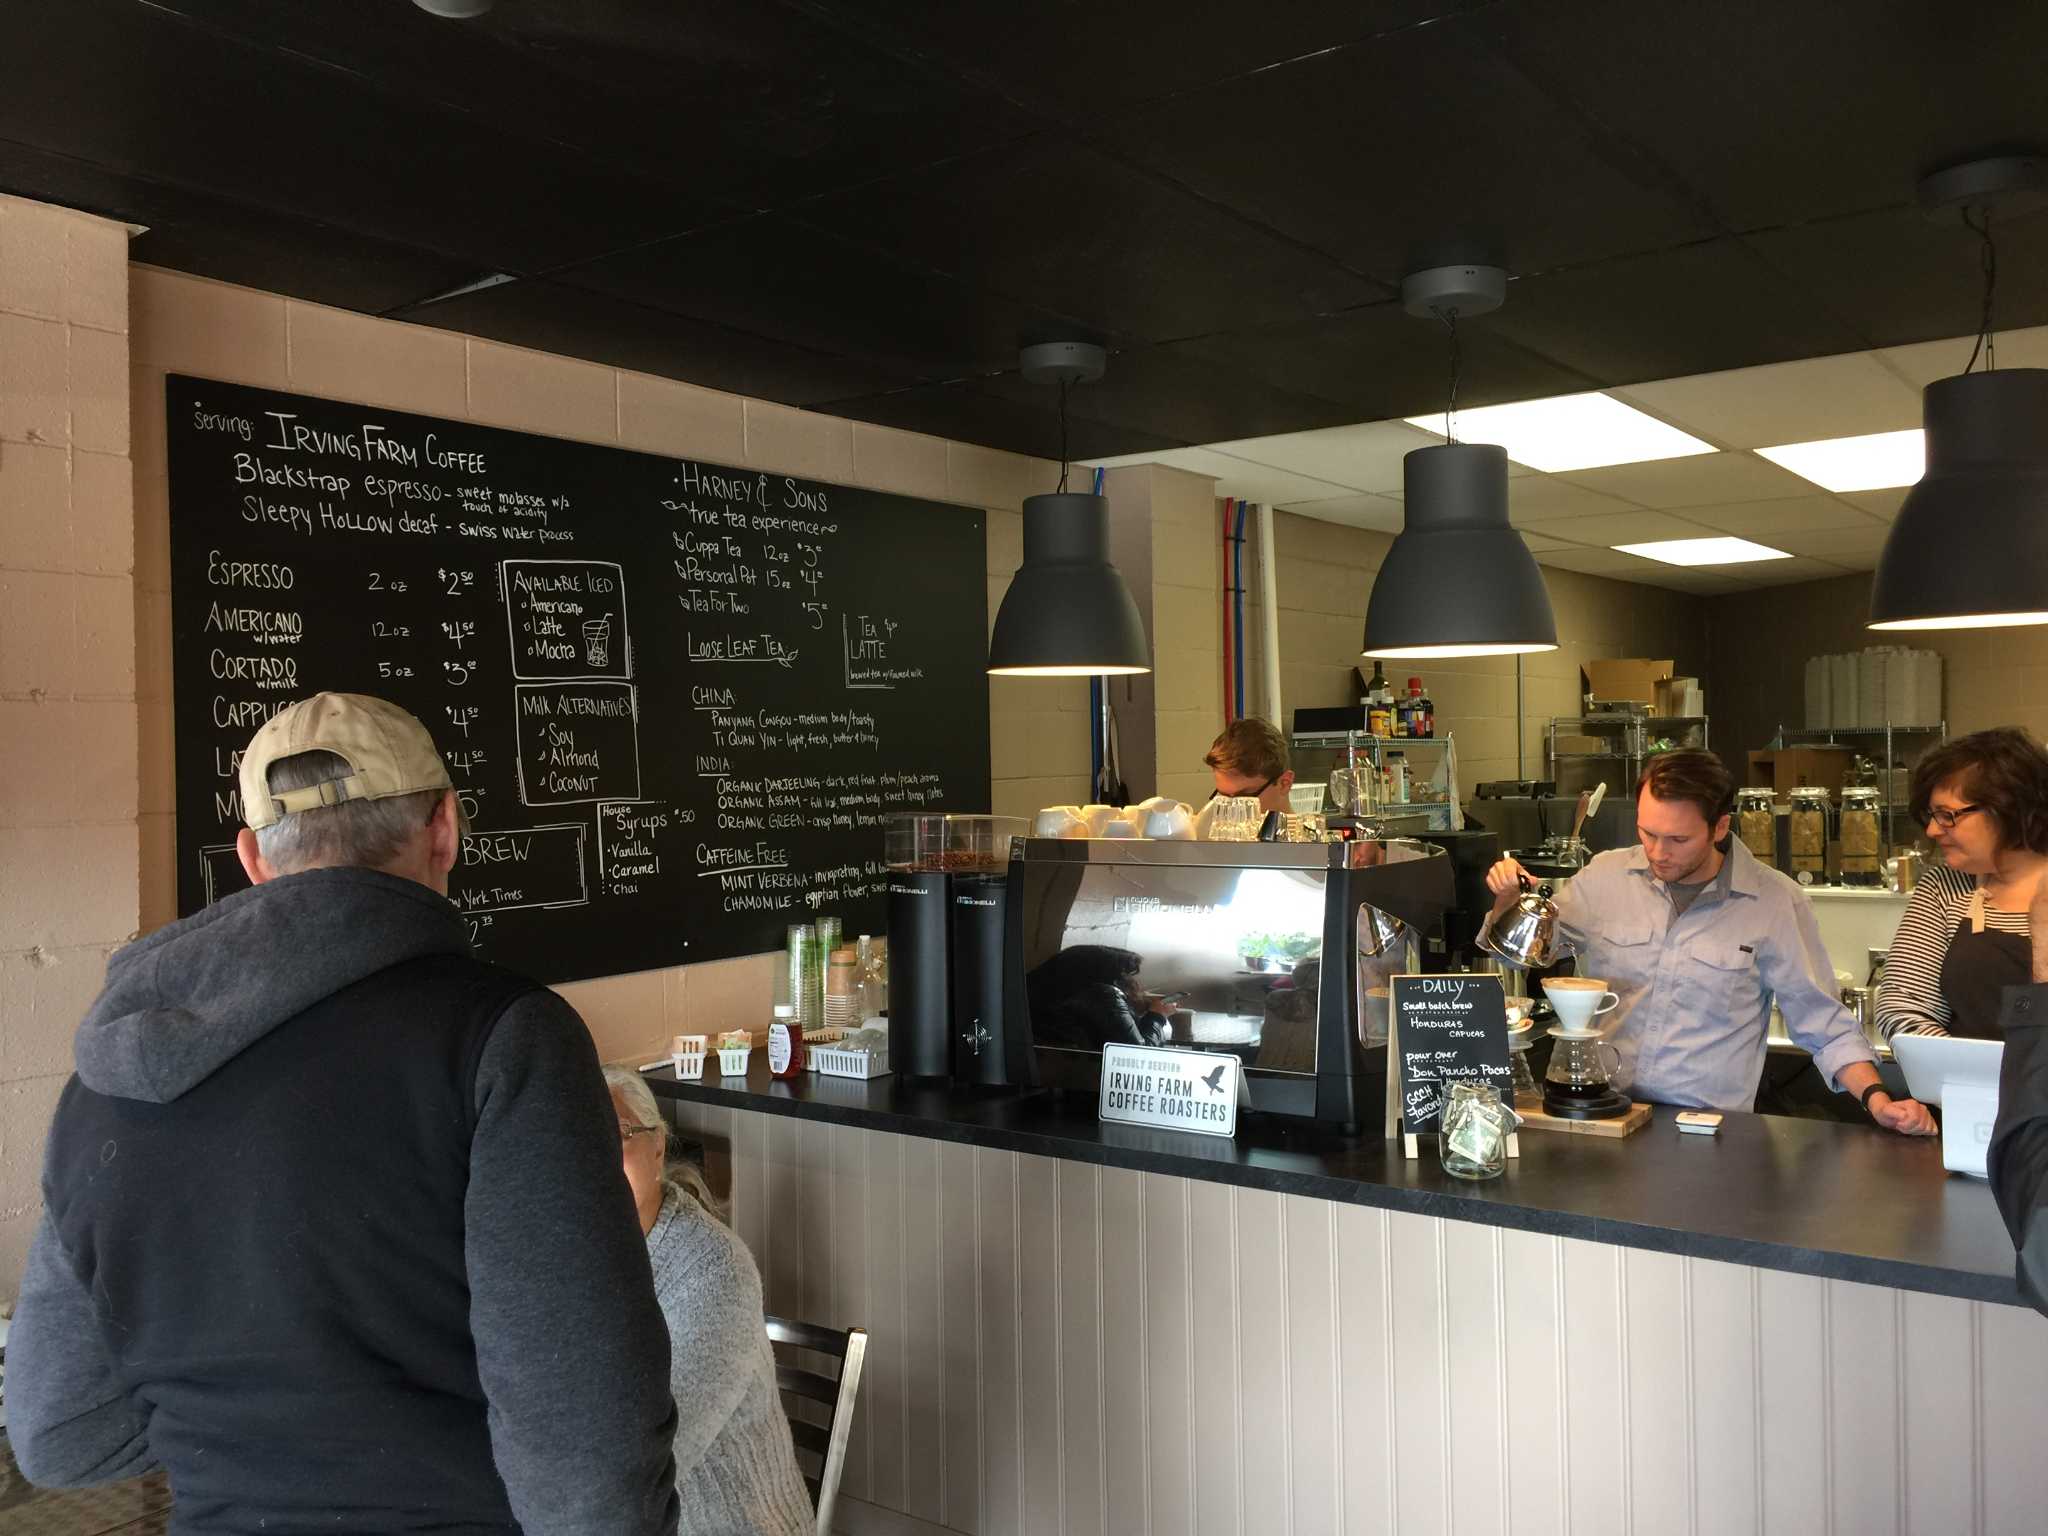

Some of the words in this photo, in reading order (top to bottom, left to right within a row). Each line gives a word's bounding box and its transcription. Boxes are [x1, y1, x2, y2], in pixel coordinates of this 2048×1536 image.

[263, 411, 362, 461] IRVING
[362, 424, 418, 468] FARM
[425, 433, 487, 473] COFFEE
[234, 452, 351, 500] Blackstrap
[456, 485, 493, 501] sweet
[681, 463, 751, 503] HARNEY
[783, 478, 828, 512] SONS
[241, 495, 313, 536] Sleepy
[398, 510, 440, 536] decaf
[538, 527, 575, 545] process
[462, 501, 494, 516] touch
[513, 506, 548, 526] acidity
[690, 501, 720, 525] true
[723, 504, 748, 529] tea
[751, 515, 820, 537] experience
[684, 531, 720, 561] Cuppa
[721, 536, 742, 558] Tea
[207, 550, 295, 590] ESPRESSO
[686, 557, 738, 585] Personal
[739, 565, 757, 586] Pot
[513, 570, 583, 595] AVAILABLE
[586, 570, 614, 594] ICED
[529, 591, 584, 616] Americano
[687, 589, 709, 613] Tea
[709, 590, 729, 612] For
[727, 592, 750, 615] Two
[203, 600, 302, 634] AMERICANO
[532, 615, 567, 637] Latte
[253, 632, 304, 645] w/water
[535, 639, 576, 661] Mocha
[687, 631, 723, 659] LOOSE
[727, 633, 758, 659] LEAF
[760, 634, 786, 658] TEA
[850, 639, 888, 660] LATTE
[210, 648, 297, 681] CORTADO
[377, 661, 392, 678] 5
[256, 677, 299, 690] w/milk
[556, 694, 632, 718] ALTERNATIVES
[548, 722, 574, 752] Soy
[728, 730, 755, 746] QUAN
[550, 746, 600, 769] Almond
[549, 771, 599, 794] COCONUT
[602, 805, 632, 817] House
[717, 795, 764, 809] ORGANIC
[768, 794, 801, 808] ASSAM
[616, 813, 668, 840] Syrups
[767, 812, 805, 830] GREEN
[462, 836, 532, 865] BREW
[611, 839, 653, 858] Vanilla
[696, 842, 755, 867] CAFFEINE
[756, 841, 788, 864] FREE
[611, 855, 660, 879] Caramel
[720, 873, 755, 892] MINT
[757, 871, 809, 891] VERBENA
[461, 888, 490, 911] York
[490, 887, 524, 904] Times
[724, 895, 792, 912] CHAMOMILE
[1422, 978, 1464, 1002] DAILY
[1402, 1001, 1427, 1011] Small
[1428, 1001, 1451, 1010] batch
[1451, 1001, 1473, 1010] brew
[1405, 1052, 1432, 1066] pour
[1434, 1050, 1458, 1060] over
[1407, 1065, 1438, 1079] Don
[1436, 1064, 1478, 1077] Pancho
[1479, 1063, 1512, 1076] Pacas
[1109, 1071, 1152, 1093] IRVING
[1157, 1077, 1193, 1098] FARM
[1108, 1090, 1155, 1113] COFFEE
[1159, 1097, 1227, 1122] ROASTERS
